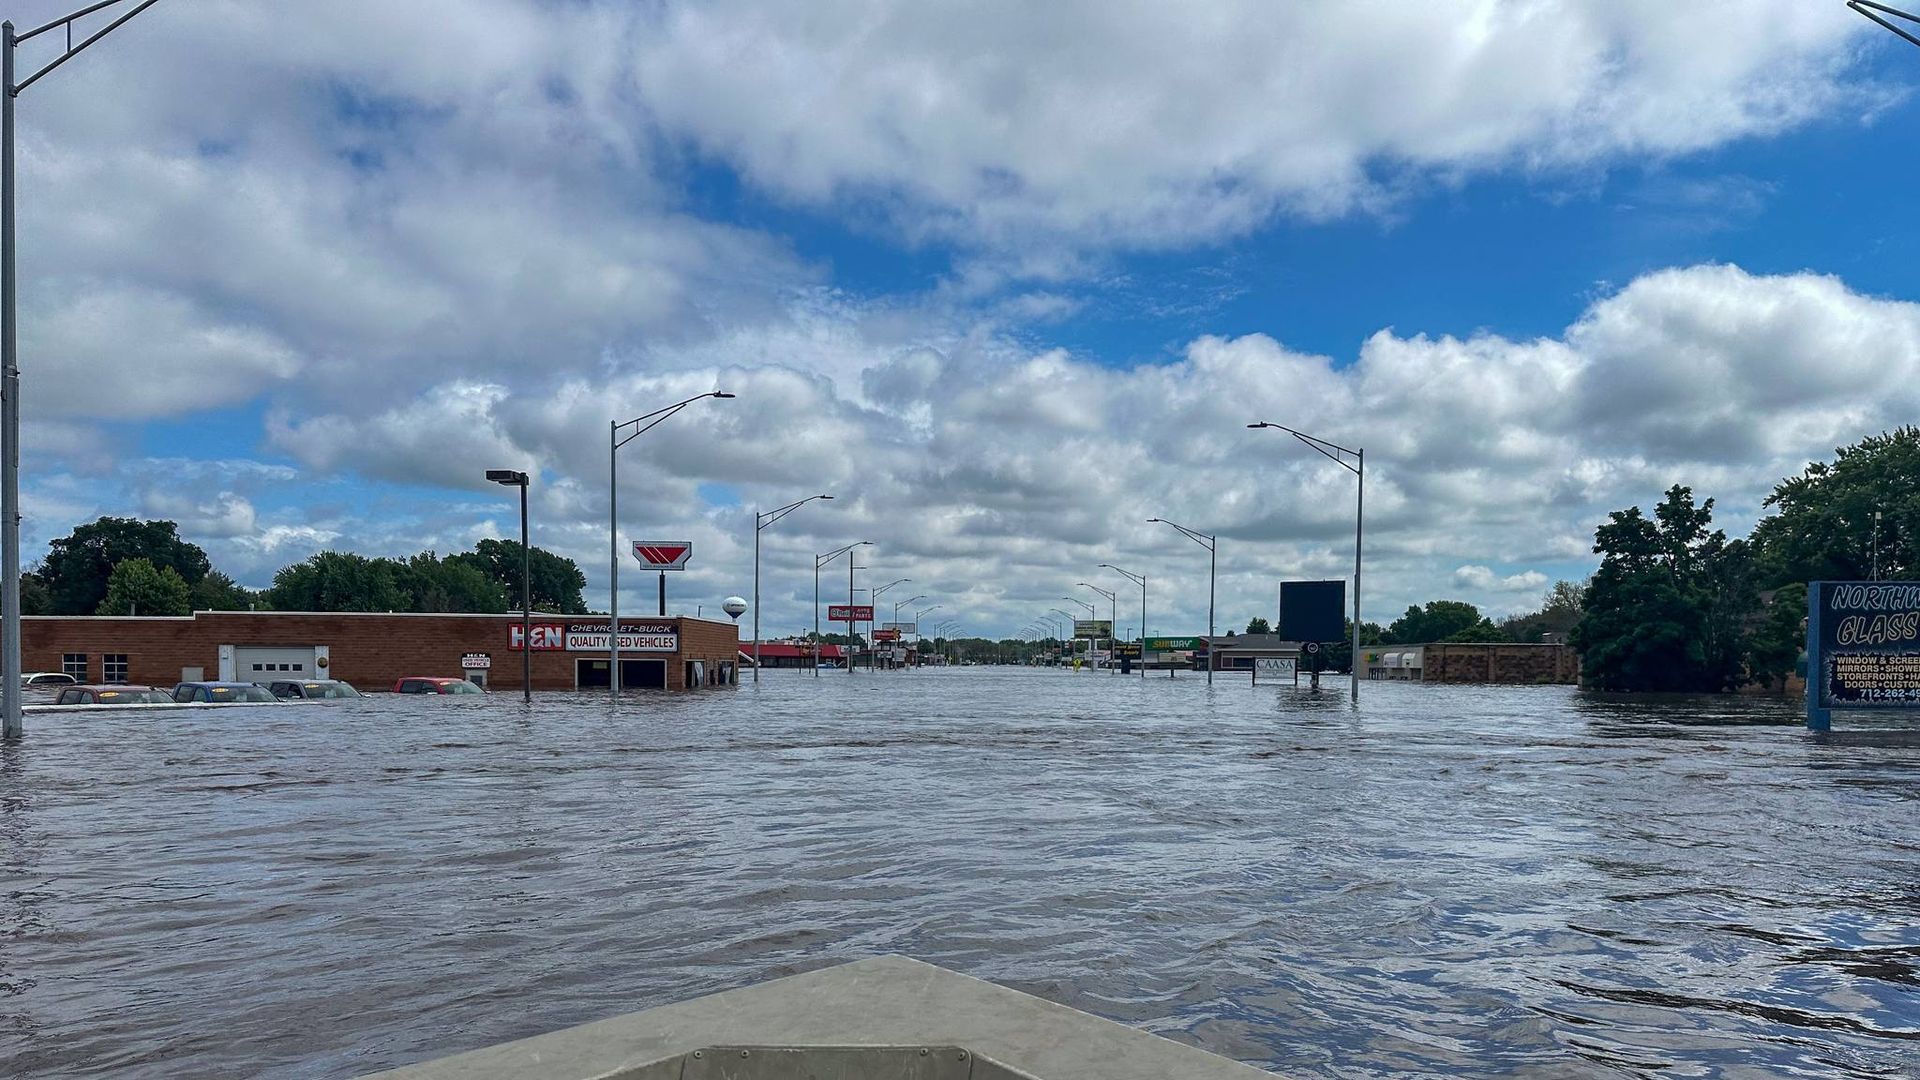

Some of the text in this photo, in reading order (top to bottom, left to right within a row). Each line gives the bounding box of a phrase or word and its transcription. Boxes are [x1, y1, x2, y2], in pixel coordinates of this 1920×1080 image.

[570, 624, 672, 633] CHEVROET-BUICK
[1836, 611, 1920, 645] GLASS
[511, 626, 562, 647] H&N
[570, 636, 606, 648] QUALITY
[633, 636, 674, 648] VEHICLES
[1152, 639, 1192, 648] SUBWAY
[1256, 659, 1293, 669] CAASA
[1836, 656, 1920, 665] WINDOW & SCREE
[1836, 664, 1920, 672] MIRRORS SHOWE
[1836, 672, 1904, 681] STOREFRONTS
[1845, 680, 1877, 689] DOORS
